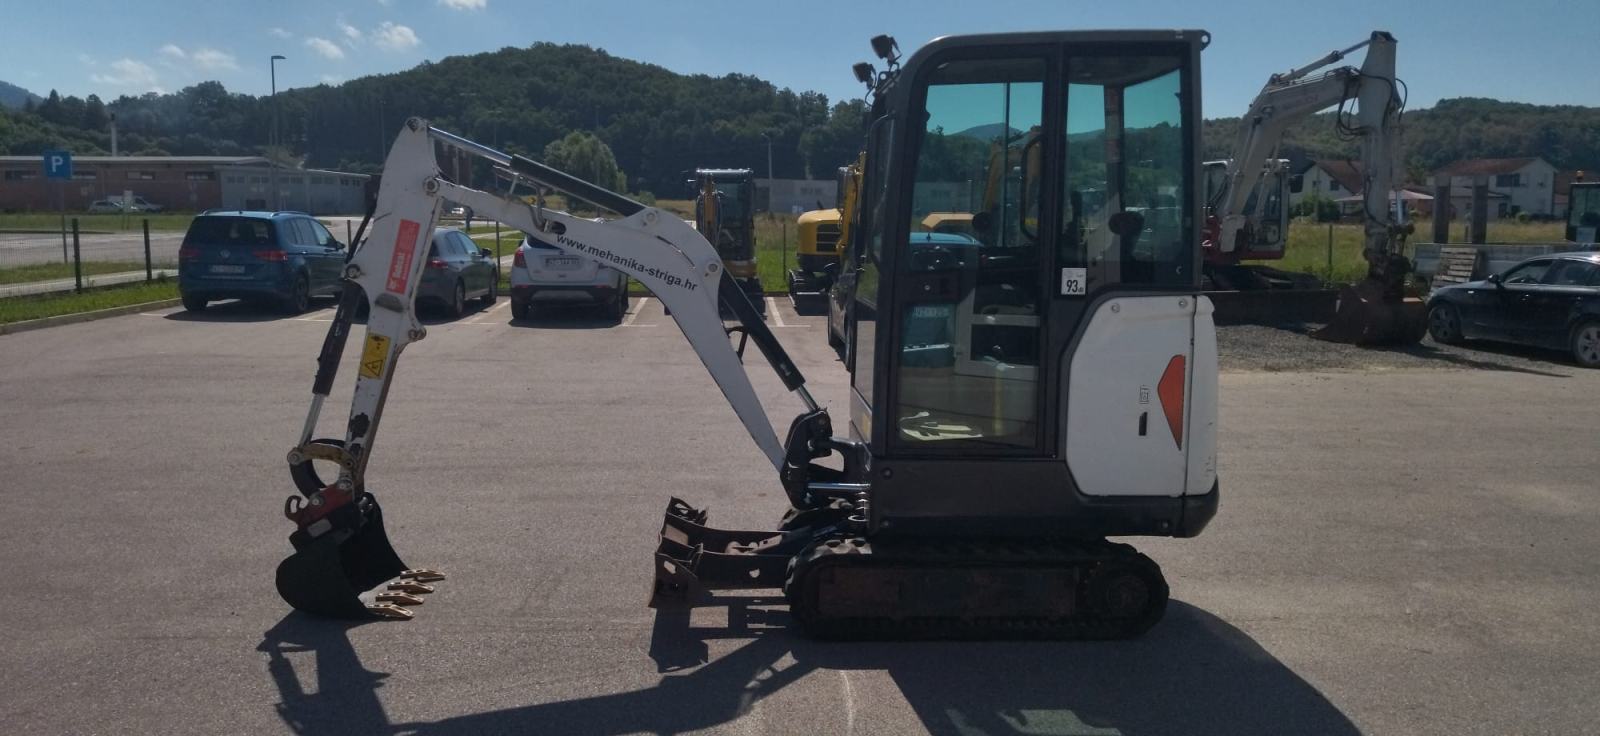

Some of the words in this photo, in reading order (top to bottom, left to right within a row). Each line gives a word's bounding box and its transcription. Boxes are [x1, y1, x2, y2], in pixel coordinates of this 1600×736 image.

[52, 156, 63, 173] P
[556, 234, 698, 292] www.mehanika-striga.hr
[1066, 279, 1078, 293] 93
